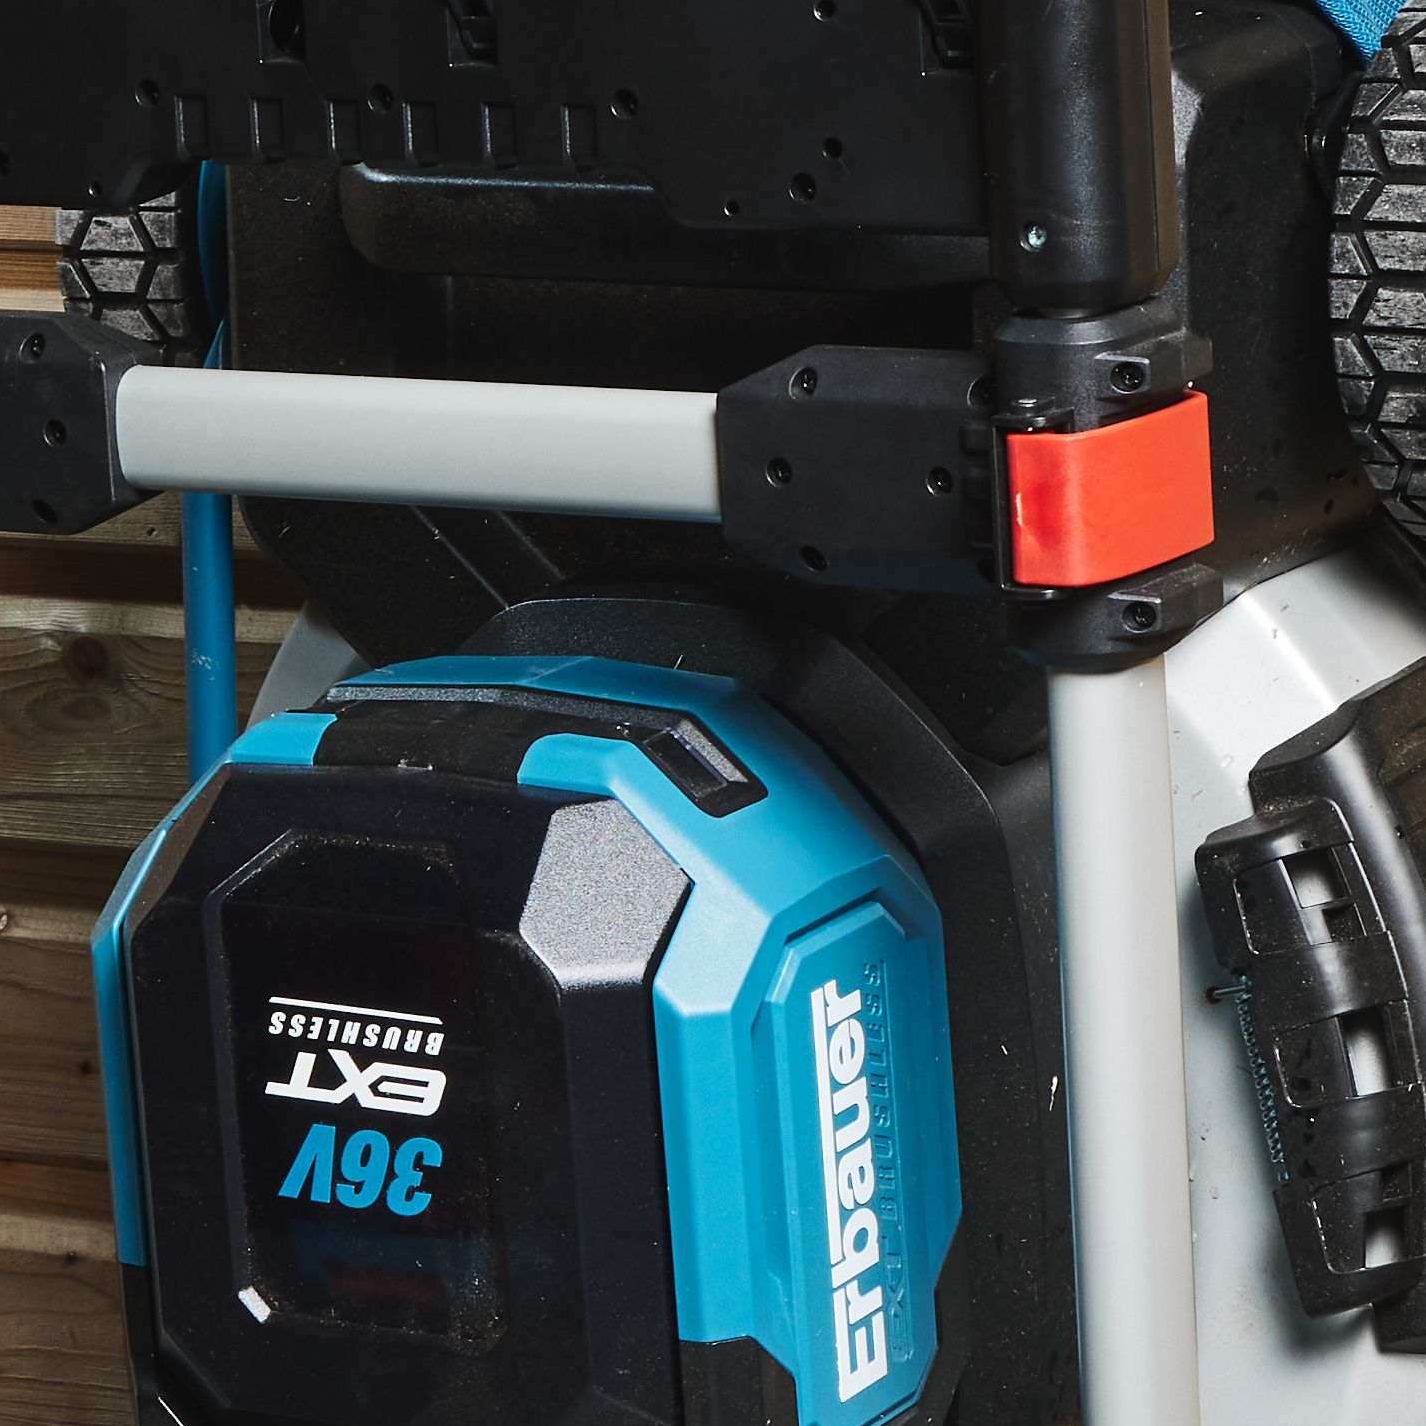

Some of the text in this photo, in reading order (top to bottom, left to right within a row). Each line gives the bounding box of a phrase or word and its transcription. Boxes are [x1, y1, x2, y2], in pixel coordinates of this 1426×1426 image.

[268, 1012, 445, 1056] BRUSHLESS
[265, 1049, 447, 1117] EXT
[862, 961, 898, 1221] BRUSHLESS
[278, 1124, 443, 1216] 36V
[811, 979, 888, 1403] Erbauer
